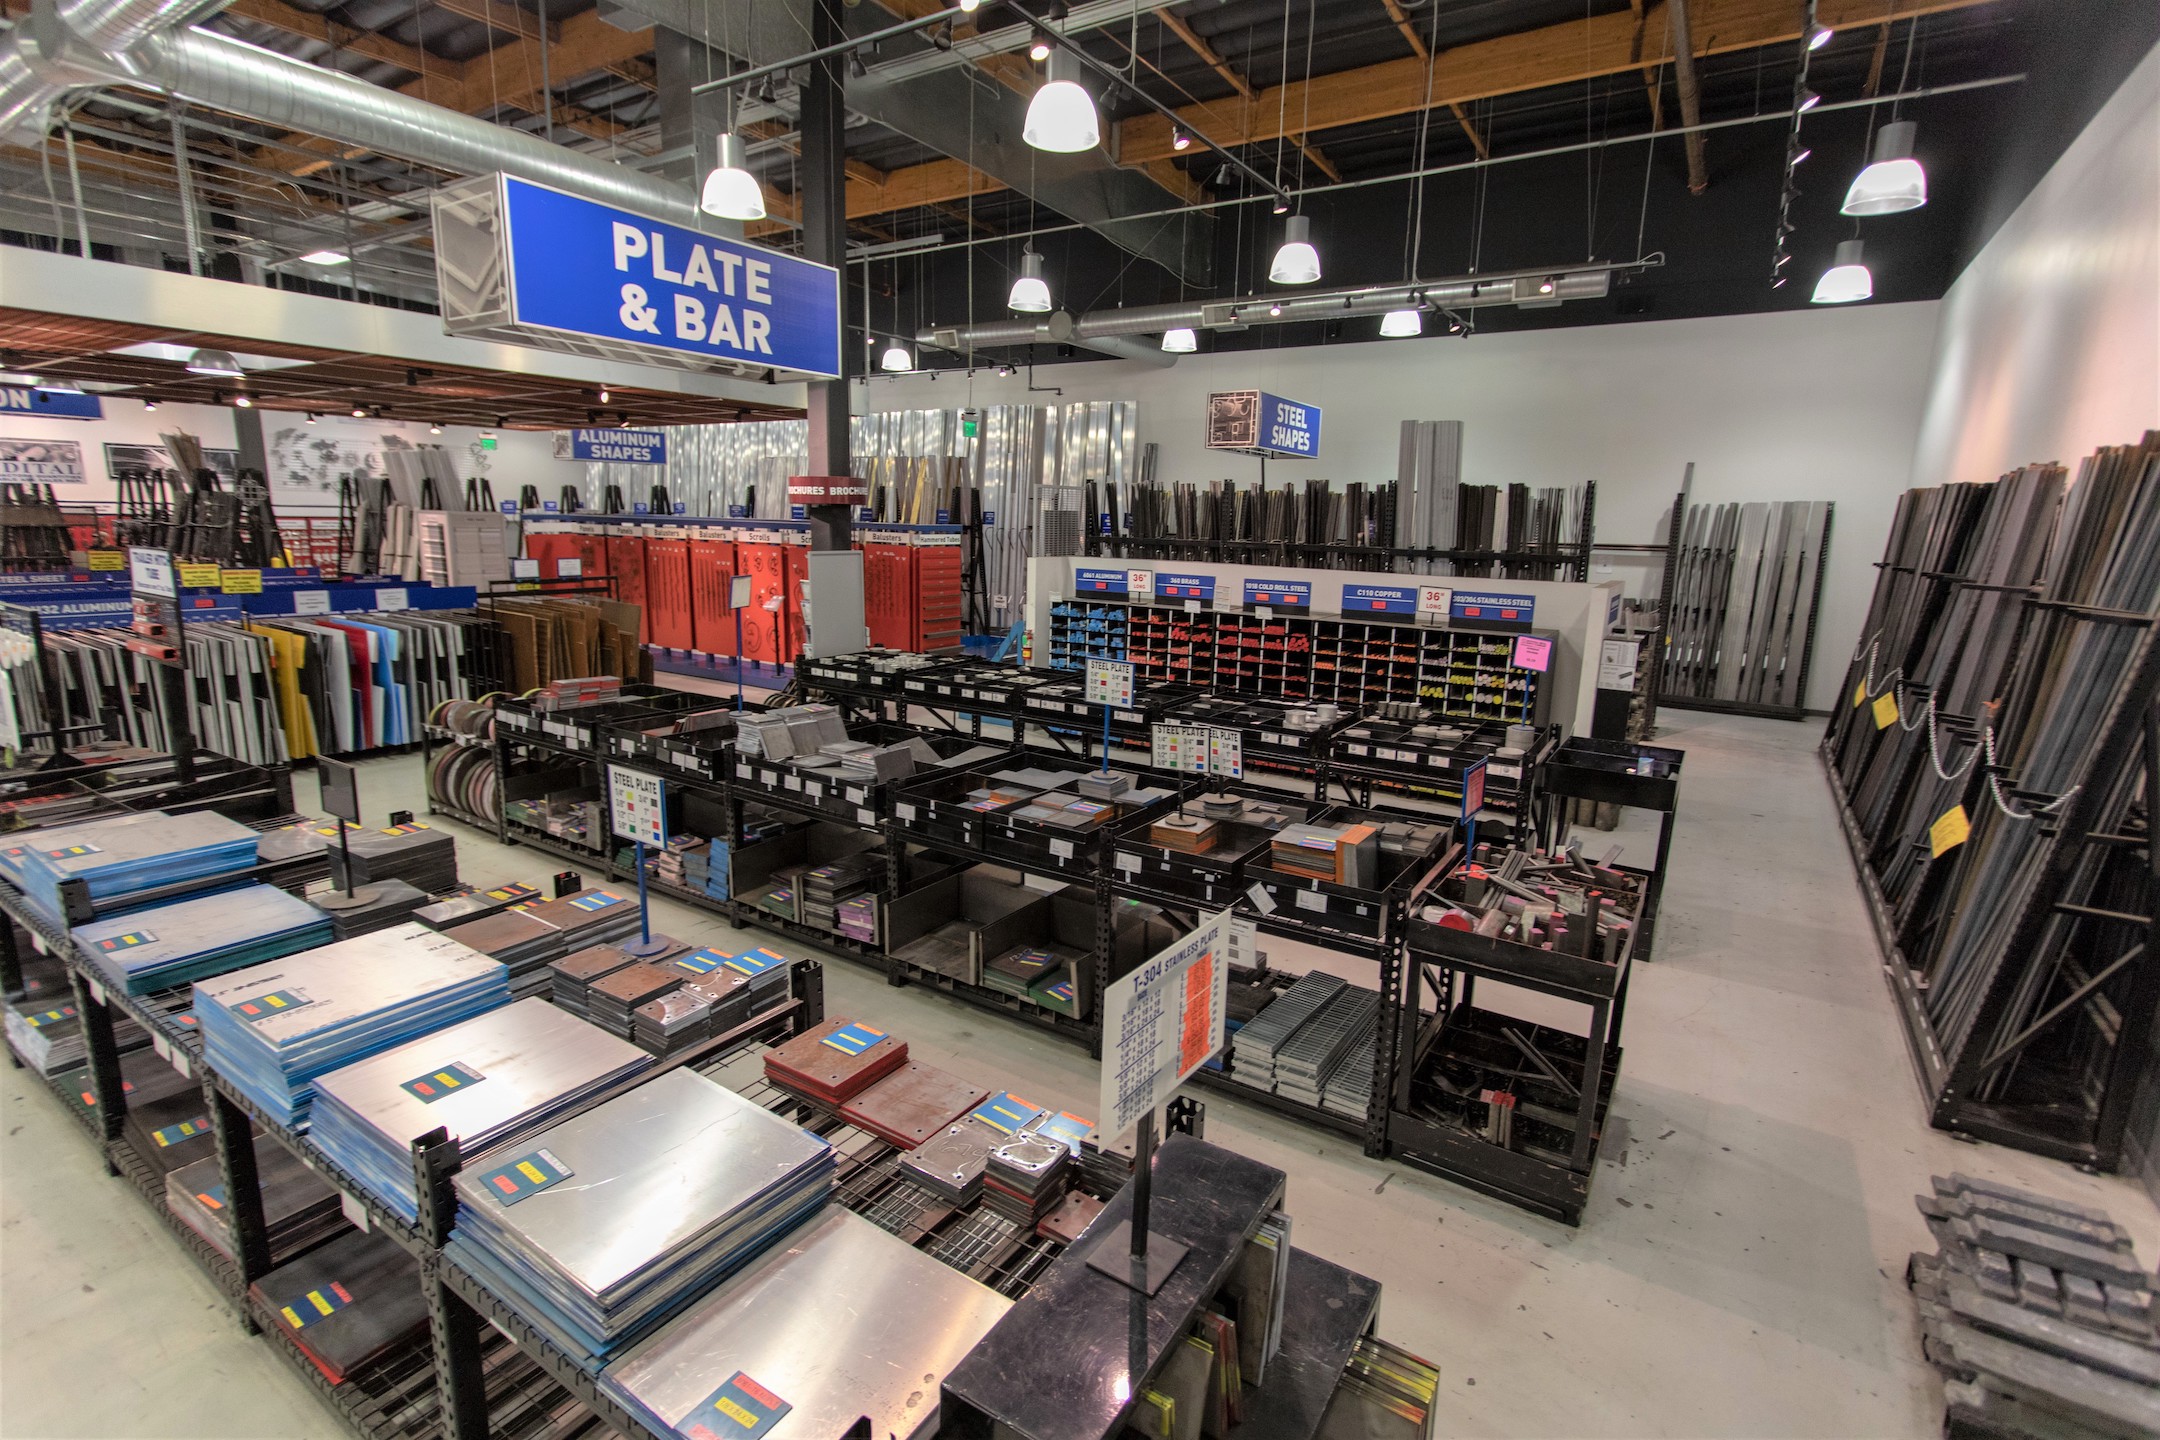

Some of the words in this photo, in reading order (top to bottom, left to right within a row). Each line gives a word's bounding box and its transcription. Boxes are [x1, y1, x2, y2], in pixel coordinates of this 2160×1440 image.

[612, 221, 772, 305] PLATE
[619, 283, 662, 335] &
[675, 293, 773, 355] BAR
[1277, 403, 1308, 429] STEEL
[578, 429, 661, 448] ALUMINUM
[1271, 425, 1310, 451] SHAPES
[591, 445, 651, 461] SHAPES
[617, 527, 633, 536] Panels
[654, 529, 679, 538] Balusters
[700, 531, 726, 539] Balusters
[750, 532, 770, 542] Scrolls
[872, 533, 902, 542] Balusters
[1374, 590, 1402, 598] COPPER
[1426, 592, 1444, 601] 36"
[1476, 596, 1512, 606] STAINLESS
[1091, 660, 1109, 671] STEEL
[1110, 664, 1130, 674] PLATE
[1157, 726, 1179, 735] STEEL
[1182, 728, 1204, 736] PLATE
[1220, 732, 1238, 742] PLATE
[614, 772, 634, 788] STEEL
[636, 778, 657, 794] PLATE
[1134, 961, 1162, 992] T-304
[1164, 941, 1199, 973] STAINLESS
[1200, 926, 1219, 948] PLATE
